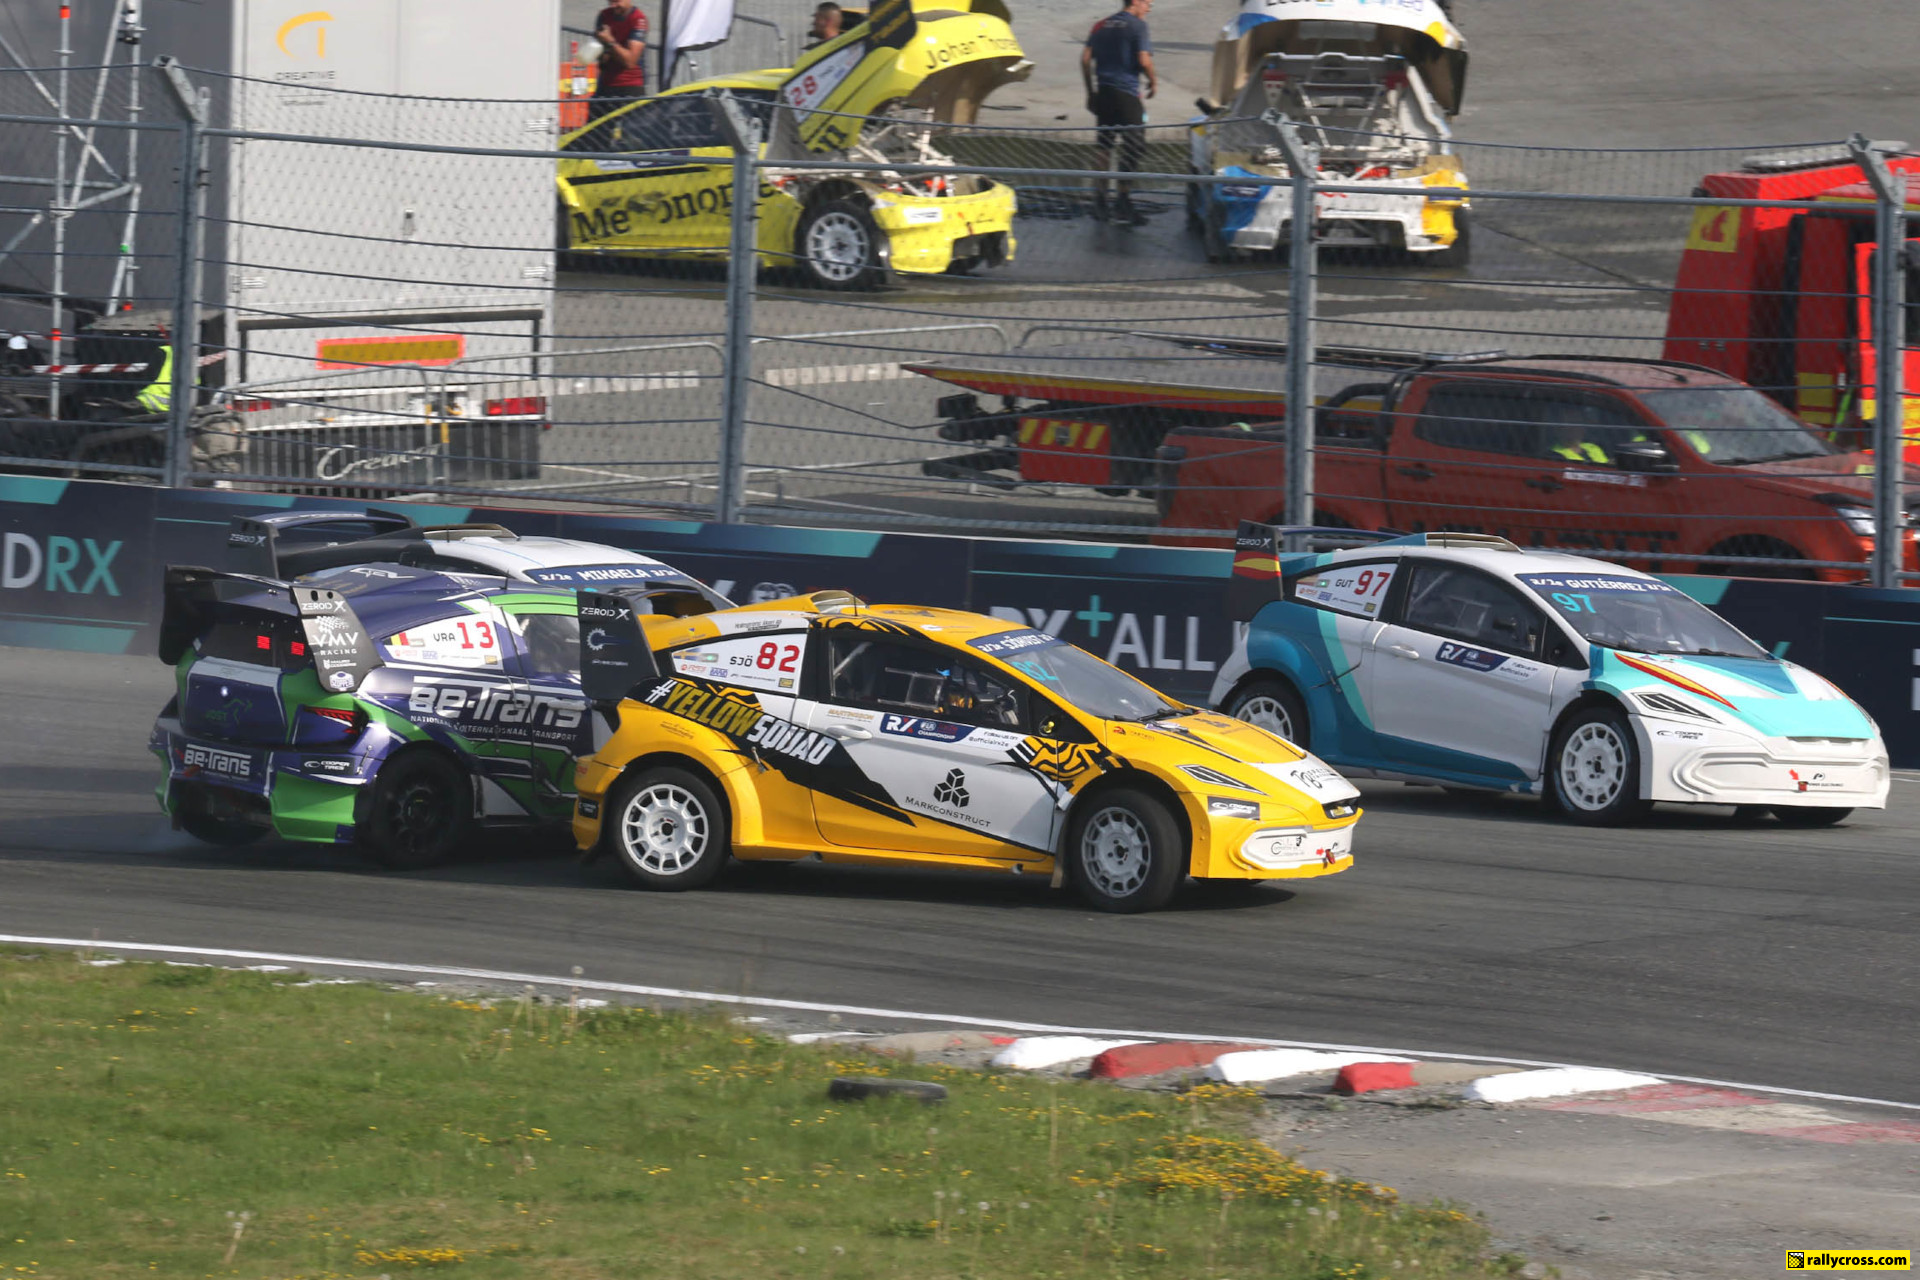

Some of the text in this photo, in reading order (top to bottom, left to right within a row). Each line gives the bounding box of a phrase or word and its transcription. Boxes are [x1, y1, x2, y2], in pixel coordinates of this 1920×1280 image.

[789, 75, 819, 107] 28
[576, 568, 651, 581] MIKAELA
[1335, 578, 1355, 588] GUT
[1354, 570, 1391, 597] 97
[1565, 577, 1648, 592] GUTIÉRREZ
[1551, 592, 1597, 613] 97
[581, 606, 630, 621] ZEROID X
[313, 631, 359, 647] VMV
[456, 621, 494, 649] 13
[320, 647, 358, 656] RACING
[729, 655, 754, 667] SJÖ
[756, 642, 800, 673] 82
[1011, 660, 1059, 682] 82
[917, 729, 957, 740] CHAMPIONSHIP
[1674, 730, 1704, 738] COOPER
[320, 760, 350, 768] COOPER
[905, 796, 992, 828] MARKCONSTRUCT
